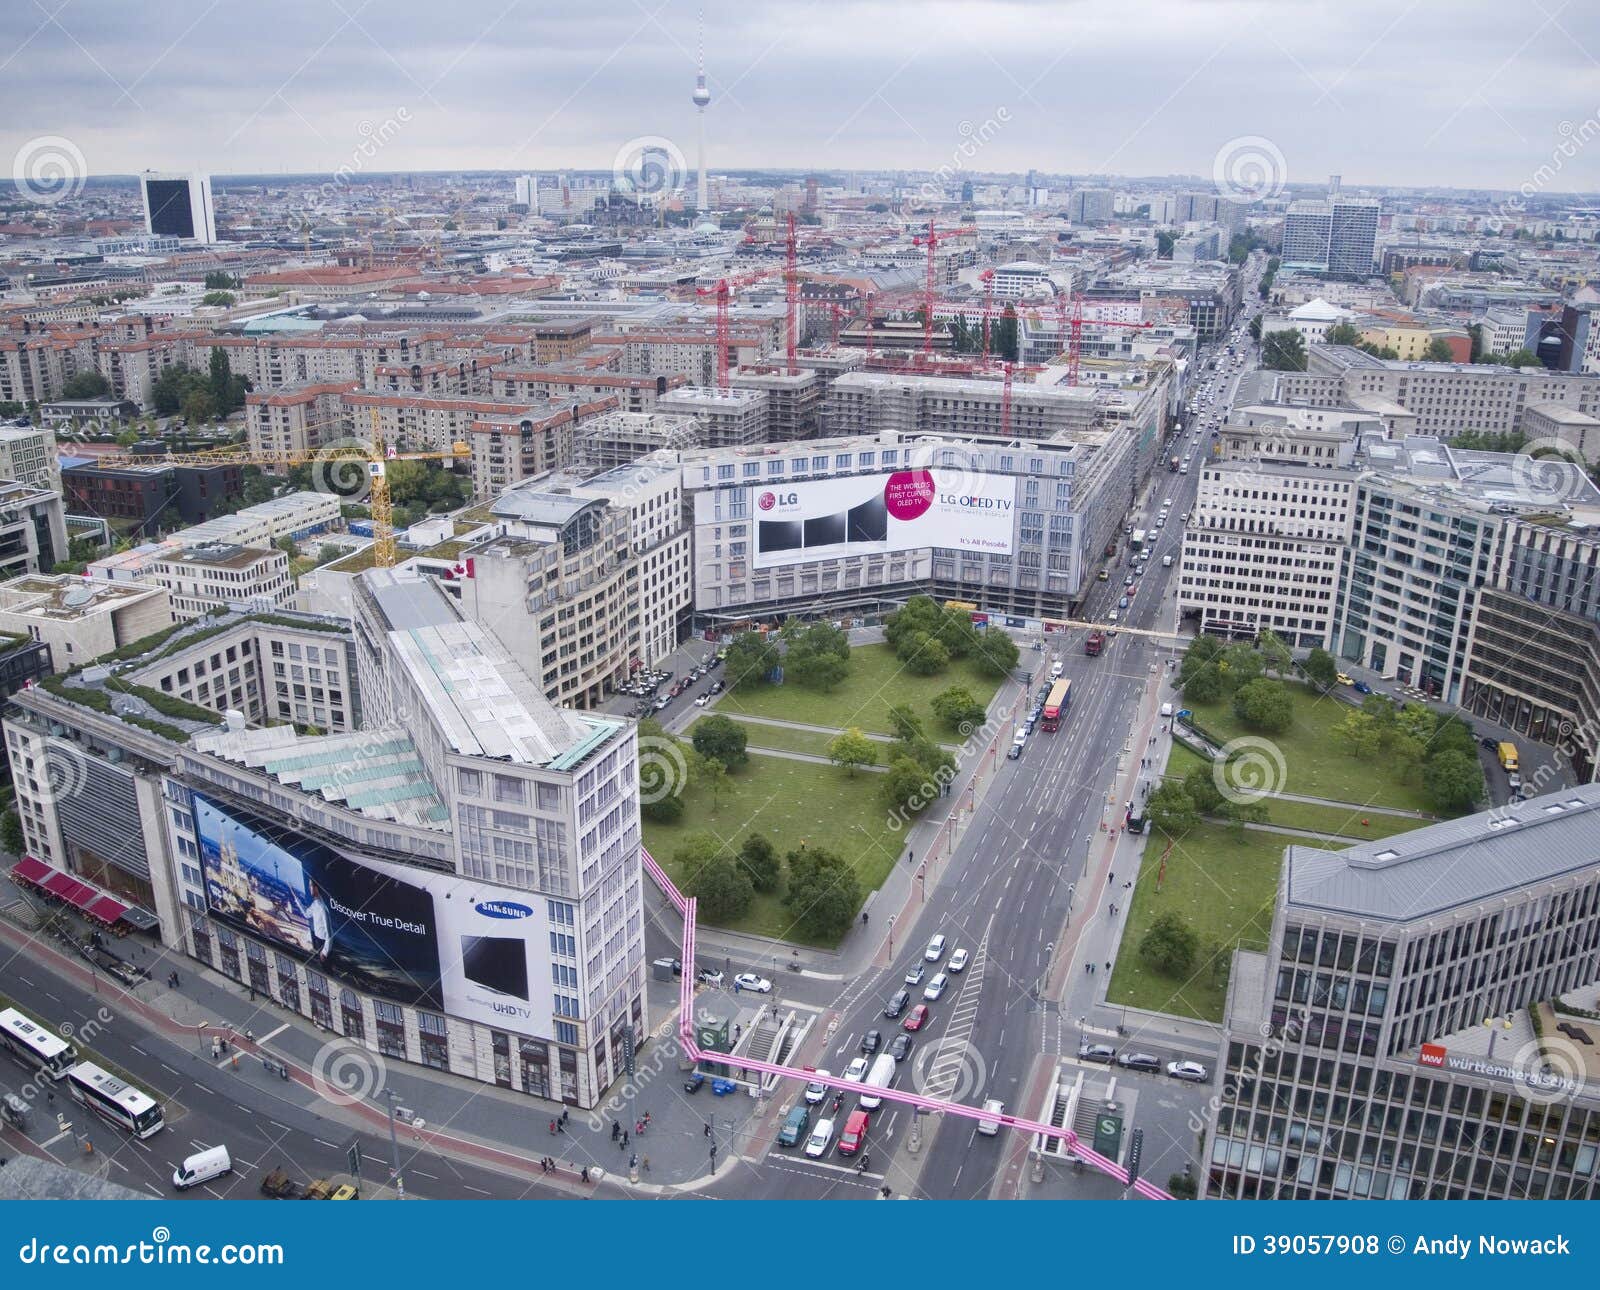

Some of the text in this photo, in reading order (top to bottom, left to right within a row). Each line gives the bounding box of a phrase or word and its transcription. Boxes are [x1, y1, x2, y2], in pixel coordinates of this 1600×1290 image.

[779, 493, 798, 506] LG
[897, 499, 913, 507] OLED
[940, 494, 1011, 510] LG OLED TV
[329, 898, 426, 935] Discover True Detail
[481, 902, 526, 918] SAMSUNG
[702, 1032, 714, 1046] S
[1101, 1119, 1116, 1135] S
